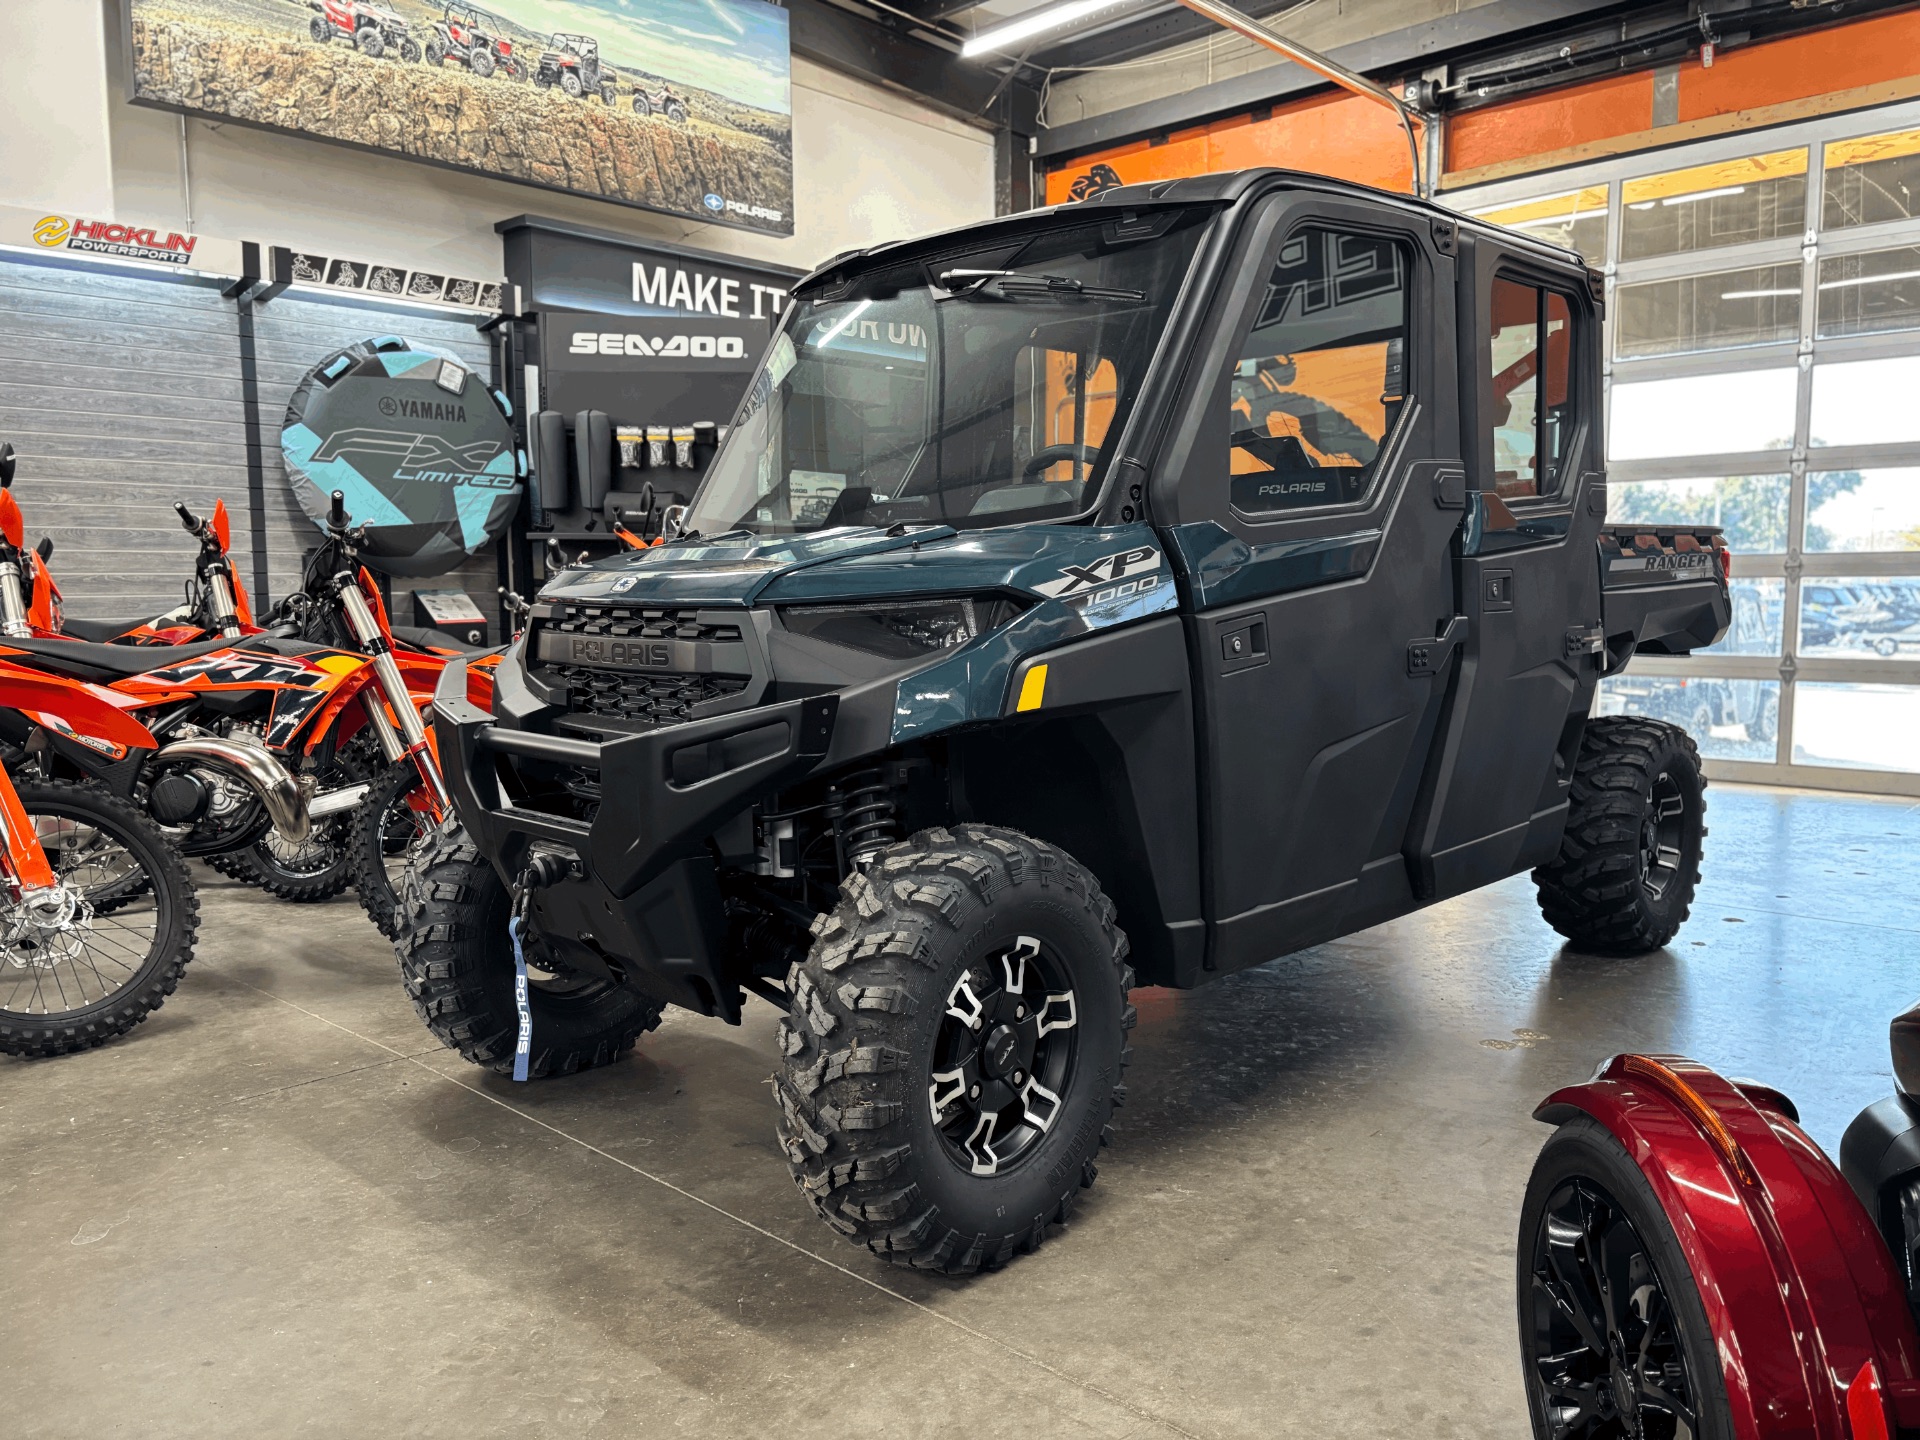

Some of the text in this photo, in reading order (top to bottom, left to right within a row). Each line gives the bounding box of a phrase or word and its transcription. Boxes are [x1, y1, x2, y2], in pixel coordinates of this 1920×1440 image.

[726, 200, 783, 222] POLARIS
[71, 219, 198, 253] HICKLIN
[70, 240, 188, 263] POWERSPORTS
[632, 262, 788, 319] MAKE IT
[399, 399, 467, 423] YAMAHA
[309, 427, 502, 473] FX
[393, 468, 516, 489] LIMITED
[1258, 482, 1326, 496] POLARIS
[1055, 546, 1157, 597] XP
[1643, 552, 1708, 572] RANGER
[1086, 575, 1159, 607] 1000
[572, 639, 670, 668] POLARIS
[77, 734, 109, 752] MOTOREX
[516, 974, 532, 1055] POLARIS
